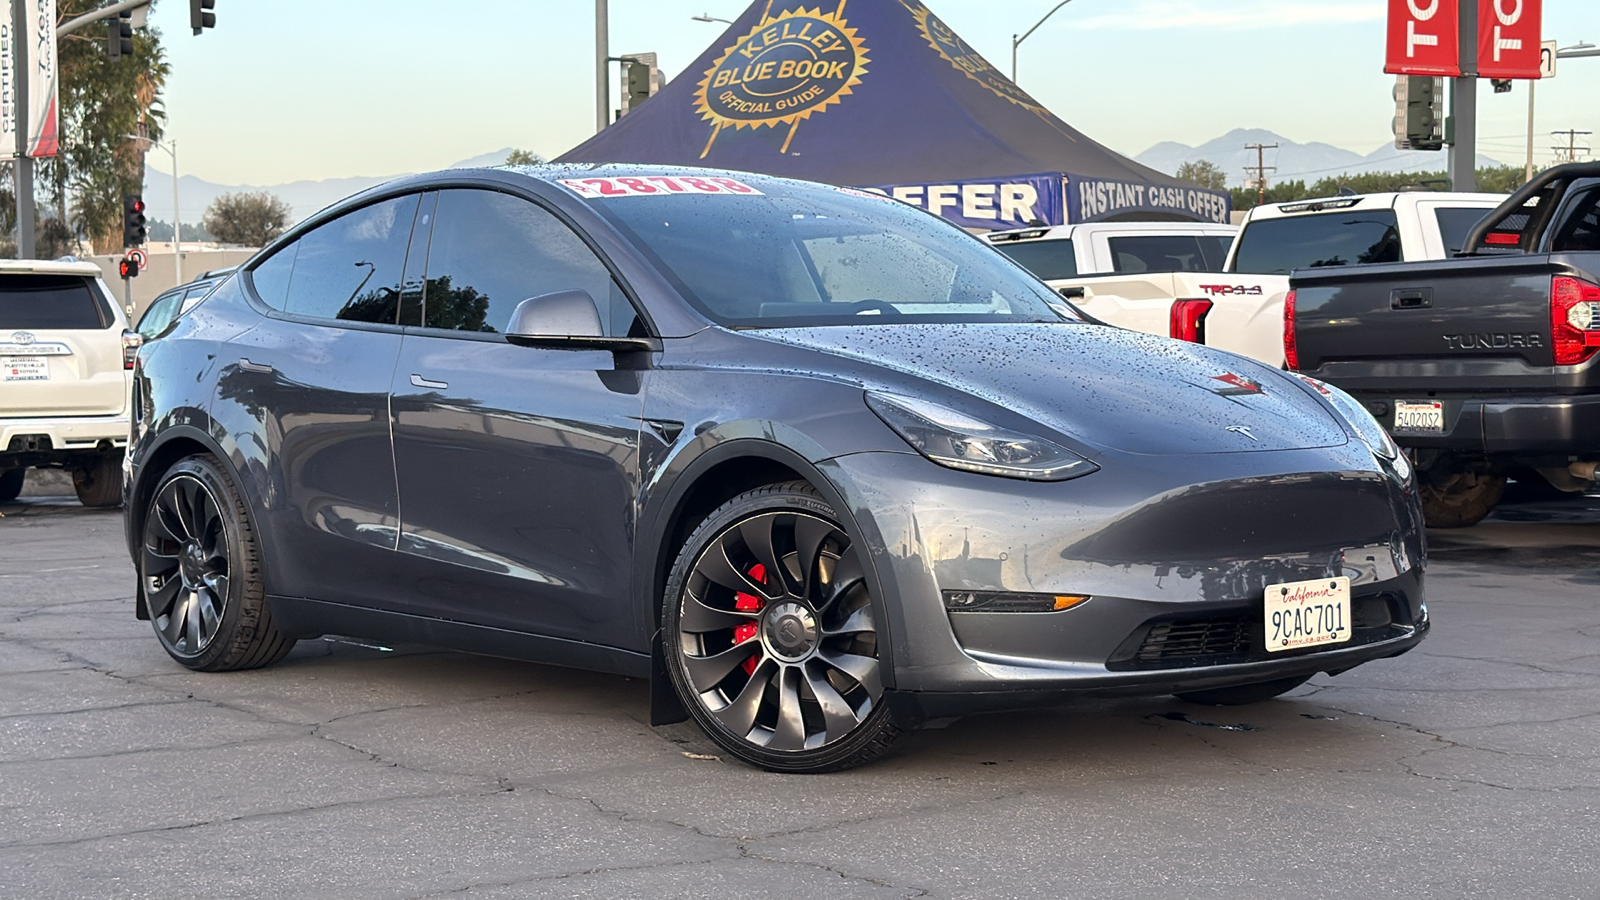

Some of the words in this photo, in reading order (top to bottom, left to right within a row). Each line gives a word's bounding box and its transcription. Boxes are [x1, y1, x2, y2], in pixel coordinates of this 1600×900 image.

[739, 22, 846, 59] KELLEY
[712, 61, 776, 88] BLUE
[777, 60, 848, 79] BOOK
[719, 90, 773, 114] OFFICIAL
[776, 85, 825, 111] GUIDE
[864, 184, 1038, 223] FFER
[1079, 181, 1144, 220] INSTANT
[1148, 187, 1185, 209] CASH
[1188, 190, 1226, 224] OFFER
[1442, 332, 1543, 349] TUNDRA
[1398, 412, 1440, 428] 54020S2
[1281, 586, 1334, 605] California
[1272, 602, 1345, 641] 9CAC701
